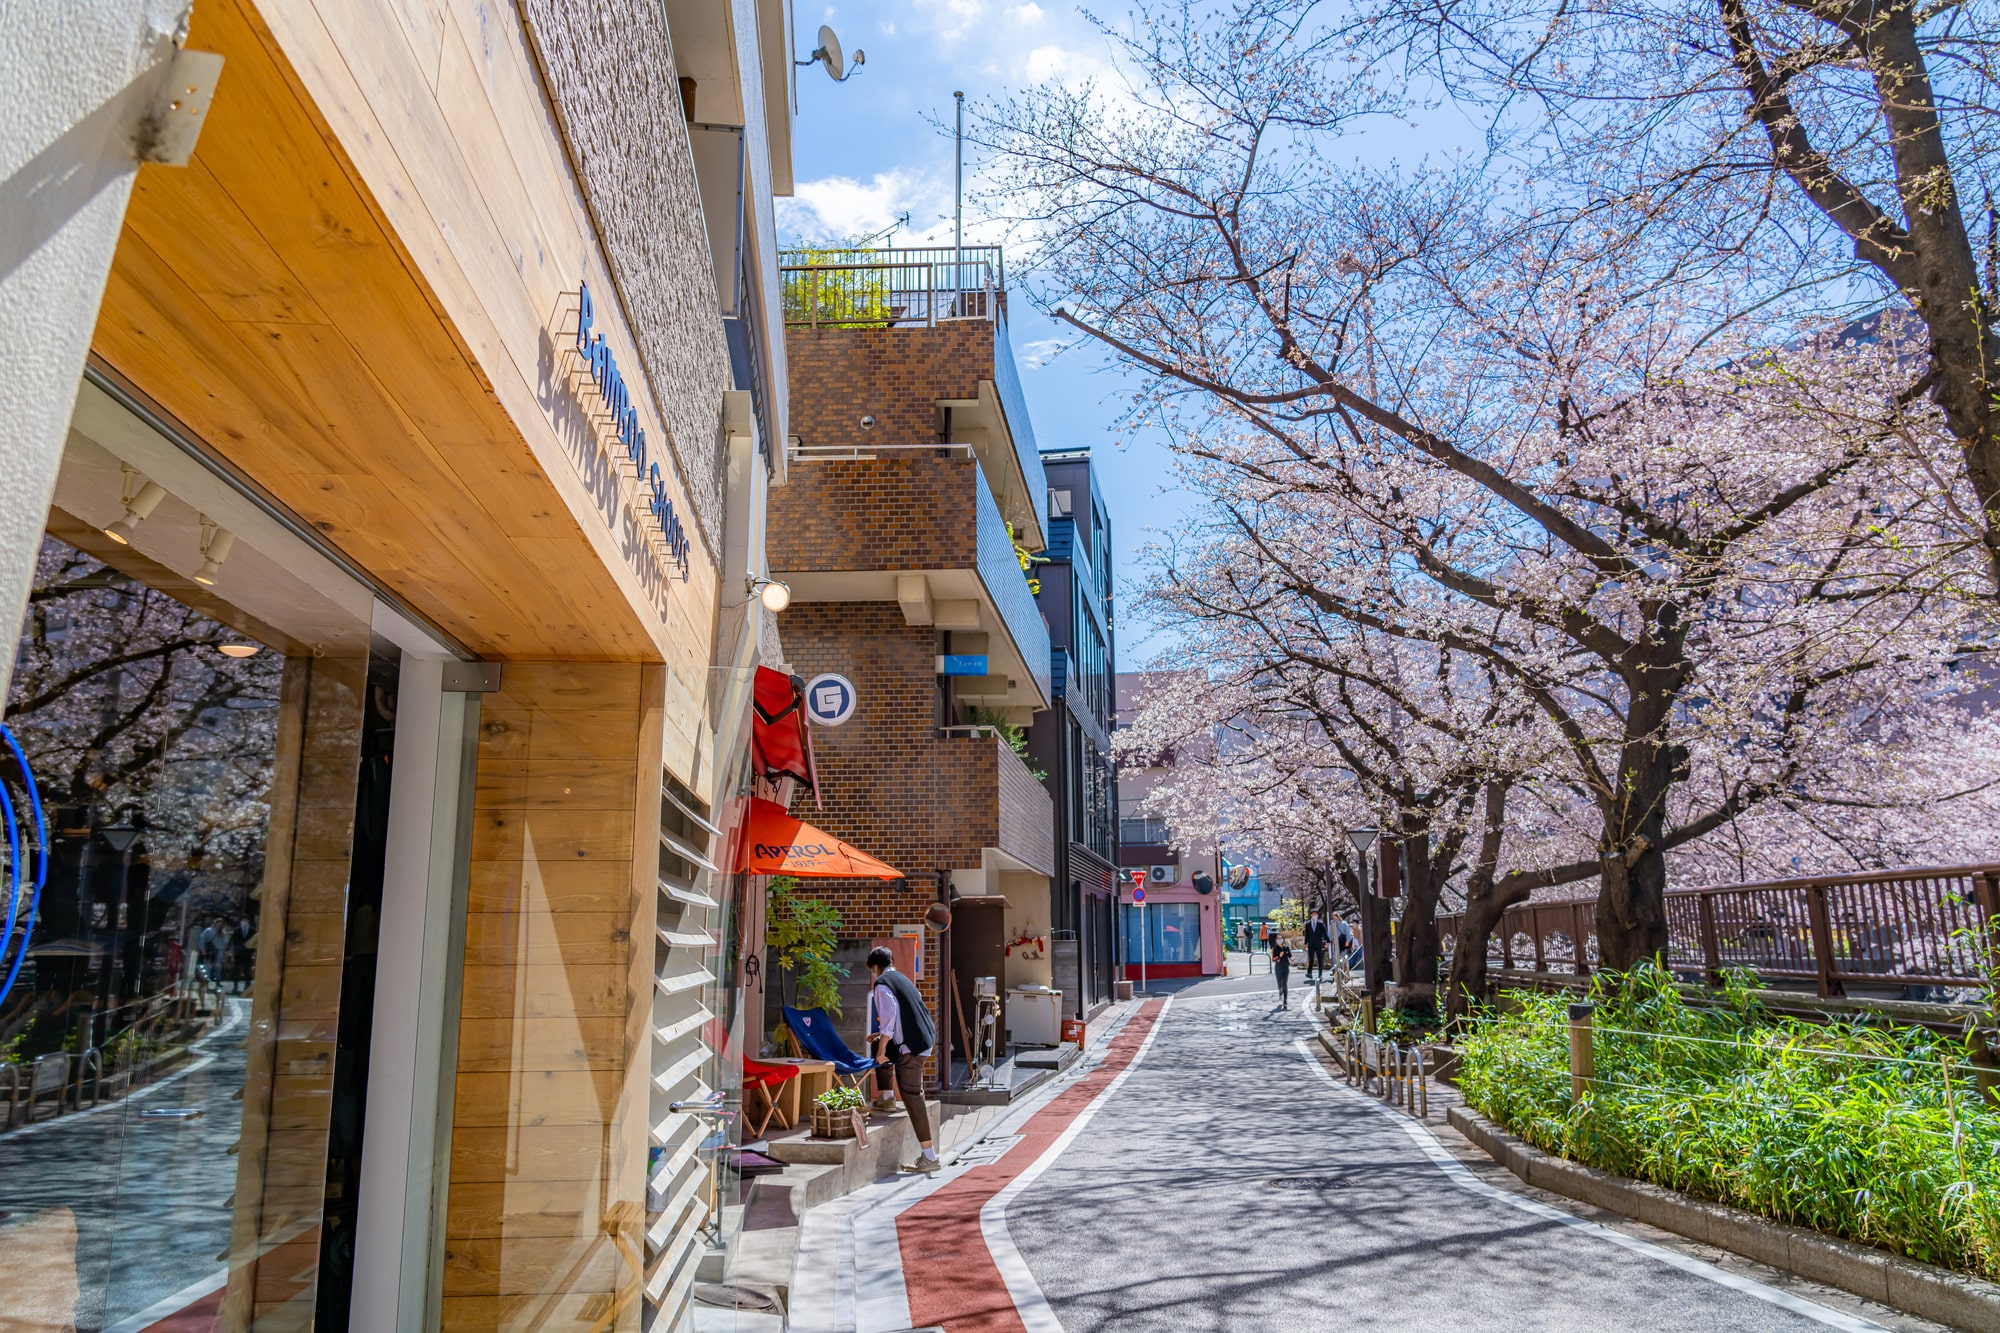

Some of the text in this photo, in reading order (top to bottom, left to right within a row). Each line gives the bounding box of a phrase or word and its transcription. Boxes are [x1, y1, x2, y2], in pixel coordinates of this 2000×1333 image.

[576, 279, 690, 584] BAMBOO SHOOTS
[754, 843, 836, 859] APEROL
[790, 860, 815, 868] 1919
